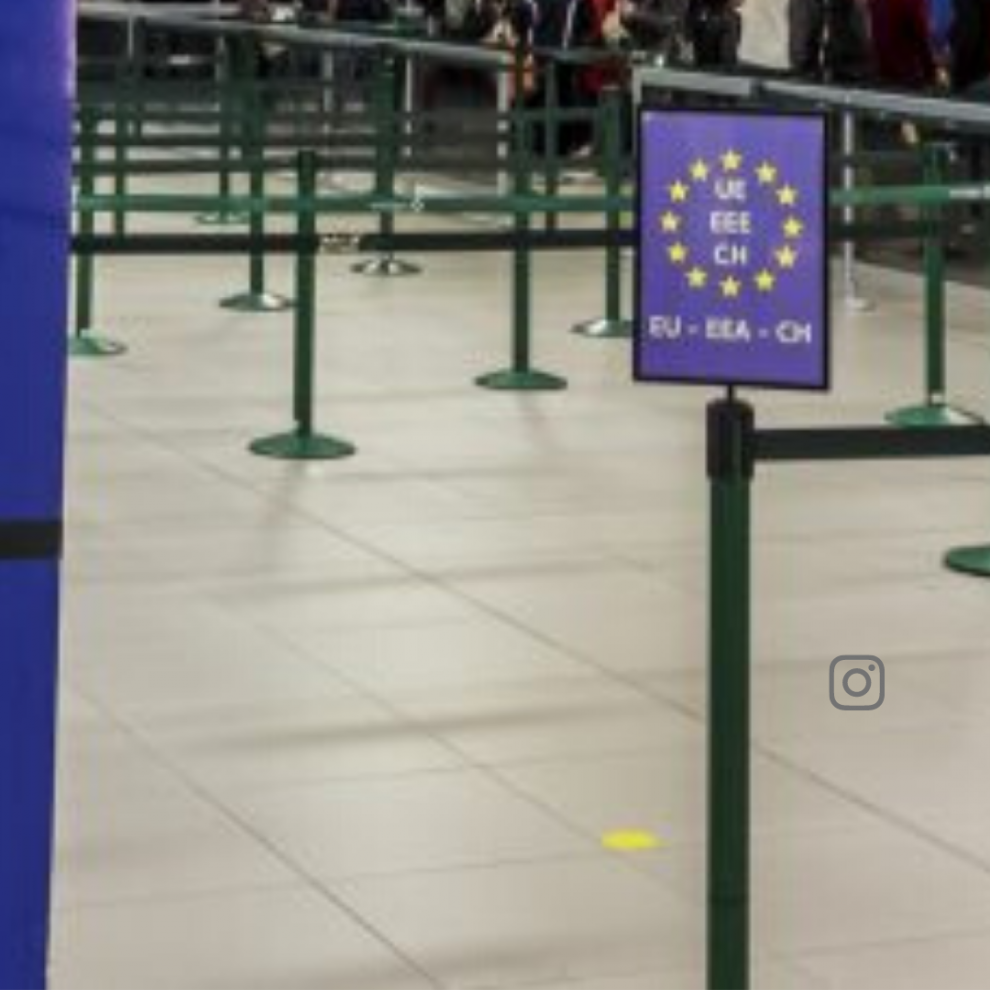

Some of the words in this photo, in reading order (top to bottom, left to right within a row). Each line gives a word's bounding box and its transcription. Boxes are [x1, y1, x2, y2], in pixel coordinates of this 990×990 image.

[714, 179, 746, 200] UE
[709, 212, 751, 234] EEE
[713, 245, 748, 265] CH
[649, 315, 682, 339] EU
[705, 317, 751, 342] EEA
[775, 321, 813, 344] CH
